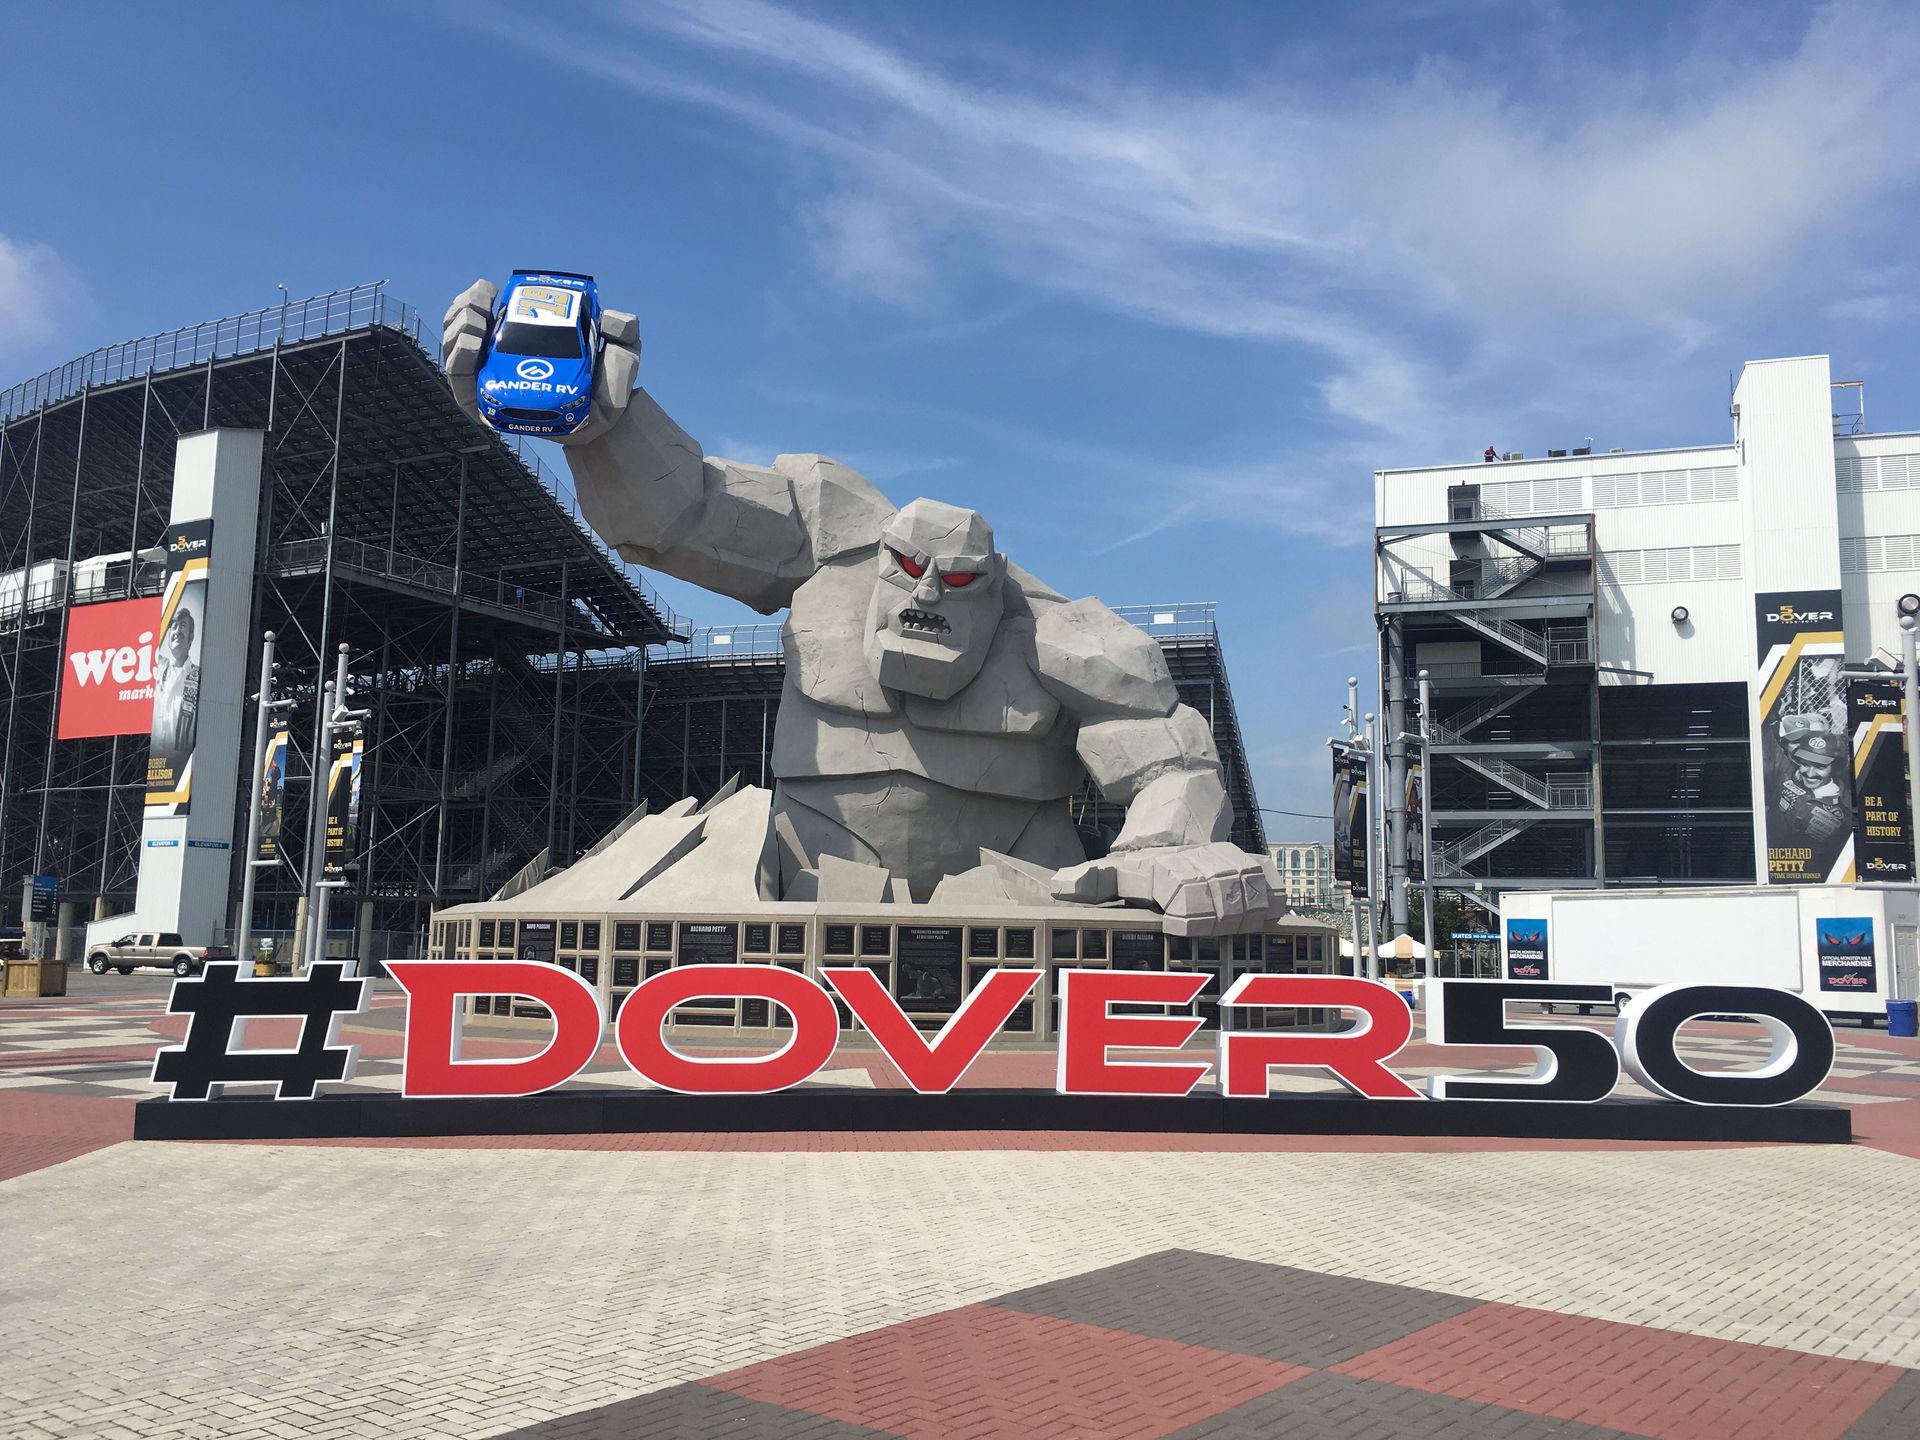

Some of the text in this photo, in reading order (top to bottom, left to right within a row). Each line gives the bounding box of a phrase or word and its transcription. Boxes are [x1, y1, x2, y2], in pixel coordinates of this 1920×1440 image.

[485, 380, 578, 394] GANDER RV
[508, 424, 540, 432] GANDER
[170, 540, 206, 552] DOVER
[1766, 612, 1834, 622] DOVER
[119, 684, 155, 700] mark
[1856, 698, 1896, 706] DOVER
[147, 768, 174, 780] ALLISON
[1864, 796, 1883, 806] BE A
[1866, 812, 1898, 822] PART OF
[1866, 826, 1902, 836] HISTORY
[1768, 848, 1812, 860] RICHARD
[1769, 860, 1804, 872] PETTY
[1866, 862, 1906, 870] DOVER
[149, 959, 1837, 1108] #DOVER50
